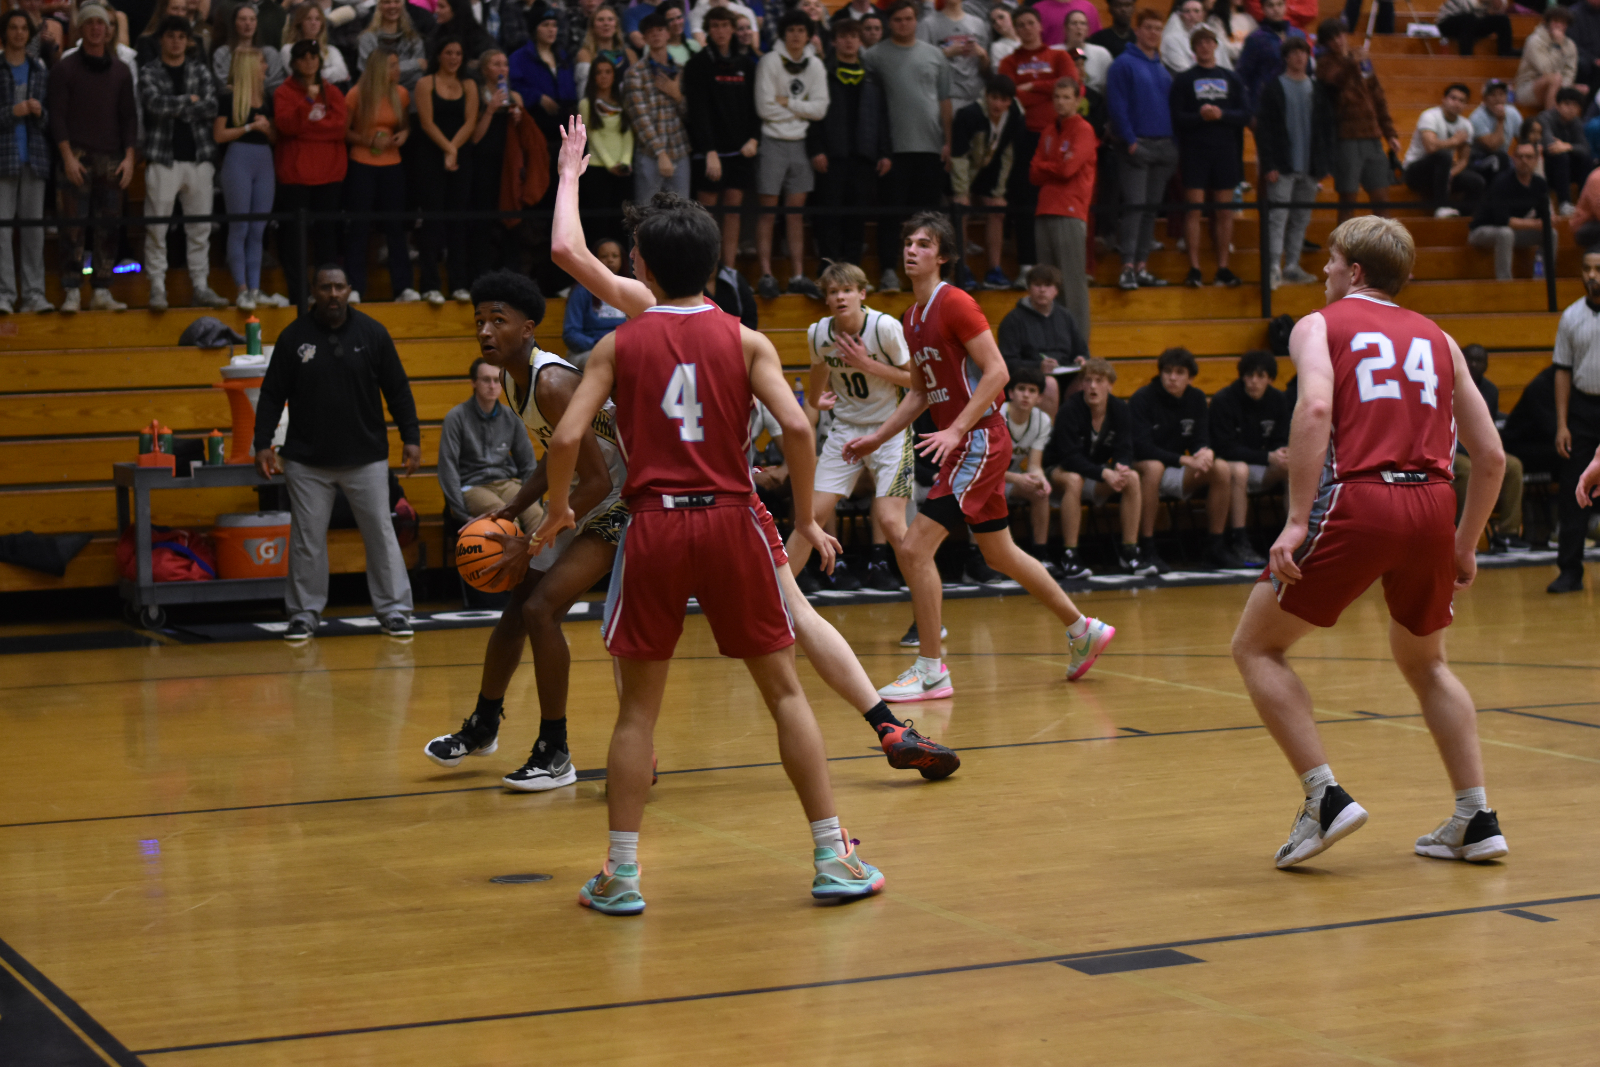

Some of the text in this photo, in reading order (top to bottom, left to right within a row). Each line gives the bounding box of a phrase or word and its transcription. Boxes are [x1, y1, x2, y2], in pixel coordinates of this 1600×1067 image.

[840, 372, 869, 399] 10
[1350, 331, 1438, 409] 24
[660, 363, 704, 442] 4
[260, 541, 275, 559] G
